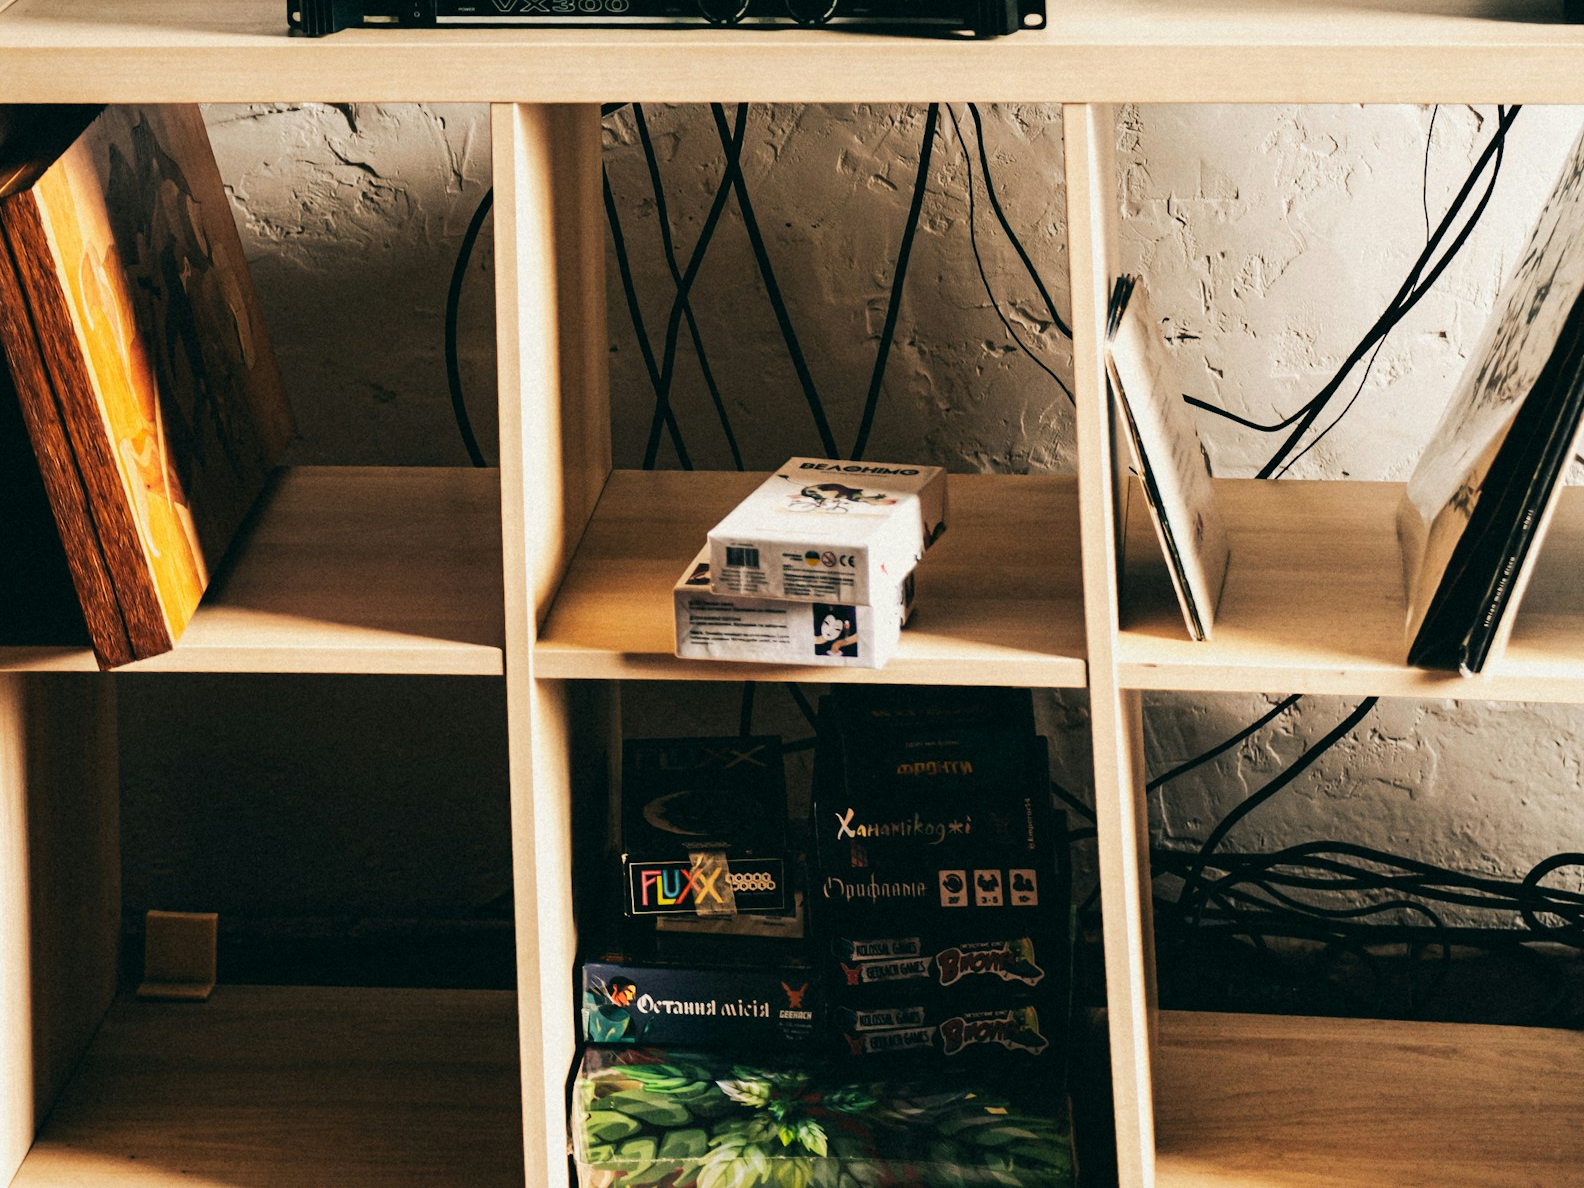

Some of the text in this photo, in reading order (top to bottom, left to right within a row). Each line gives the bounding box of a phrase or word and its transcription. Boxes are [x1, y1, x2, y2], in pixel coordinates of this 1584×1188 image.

[1483, 604, 1496, 628] simian
[1494, 577, 1507, 602] mobile
[1504, 556, 1516, 576] disco
[640, 866, 725, 907] FLUXX
[636, 993, 770, 1018] Остання місія
